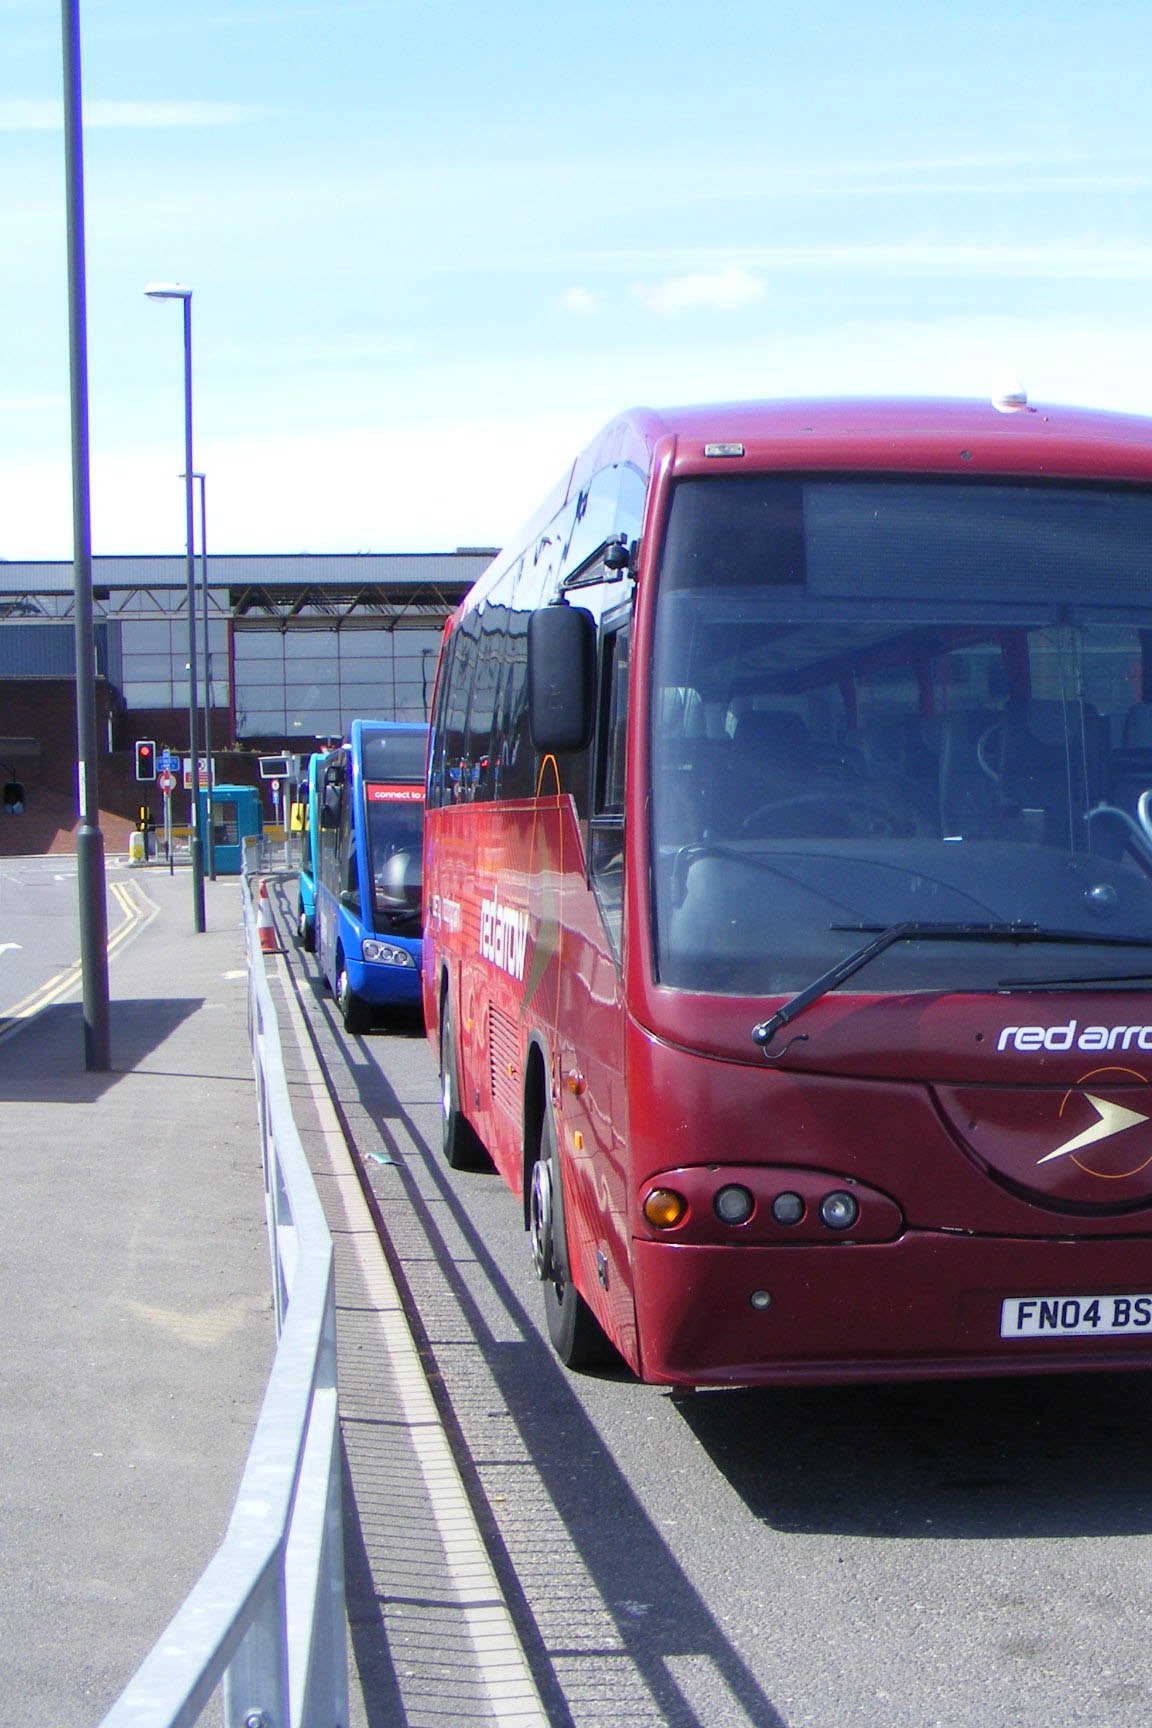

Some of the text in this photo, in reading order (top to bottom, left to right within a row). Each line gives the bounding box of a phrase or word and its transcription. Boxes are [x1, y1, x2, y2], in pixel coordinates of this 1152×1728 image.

[374, 791, 410, 799] connect
[411, 791, 422, 799] to
[1017, 1300, 1101, 1330] FN04
